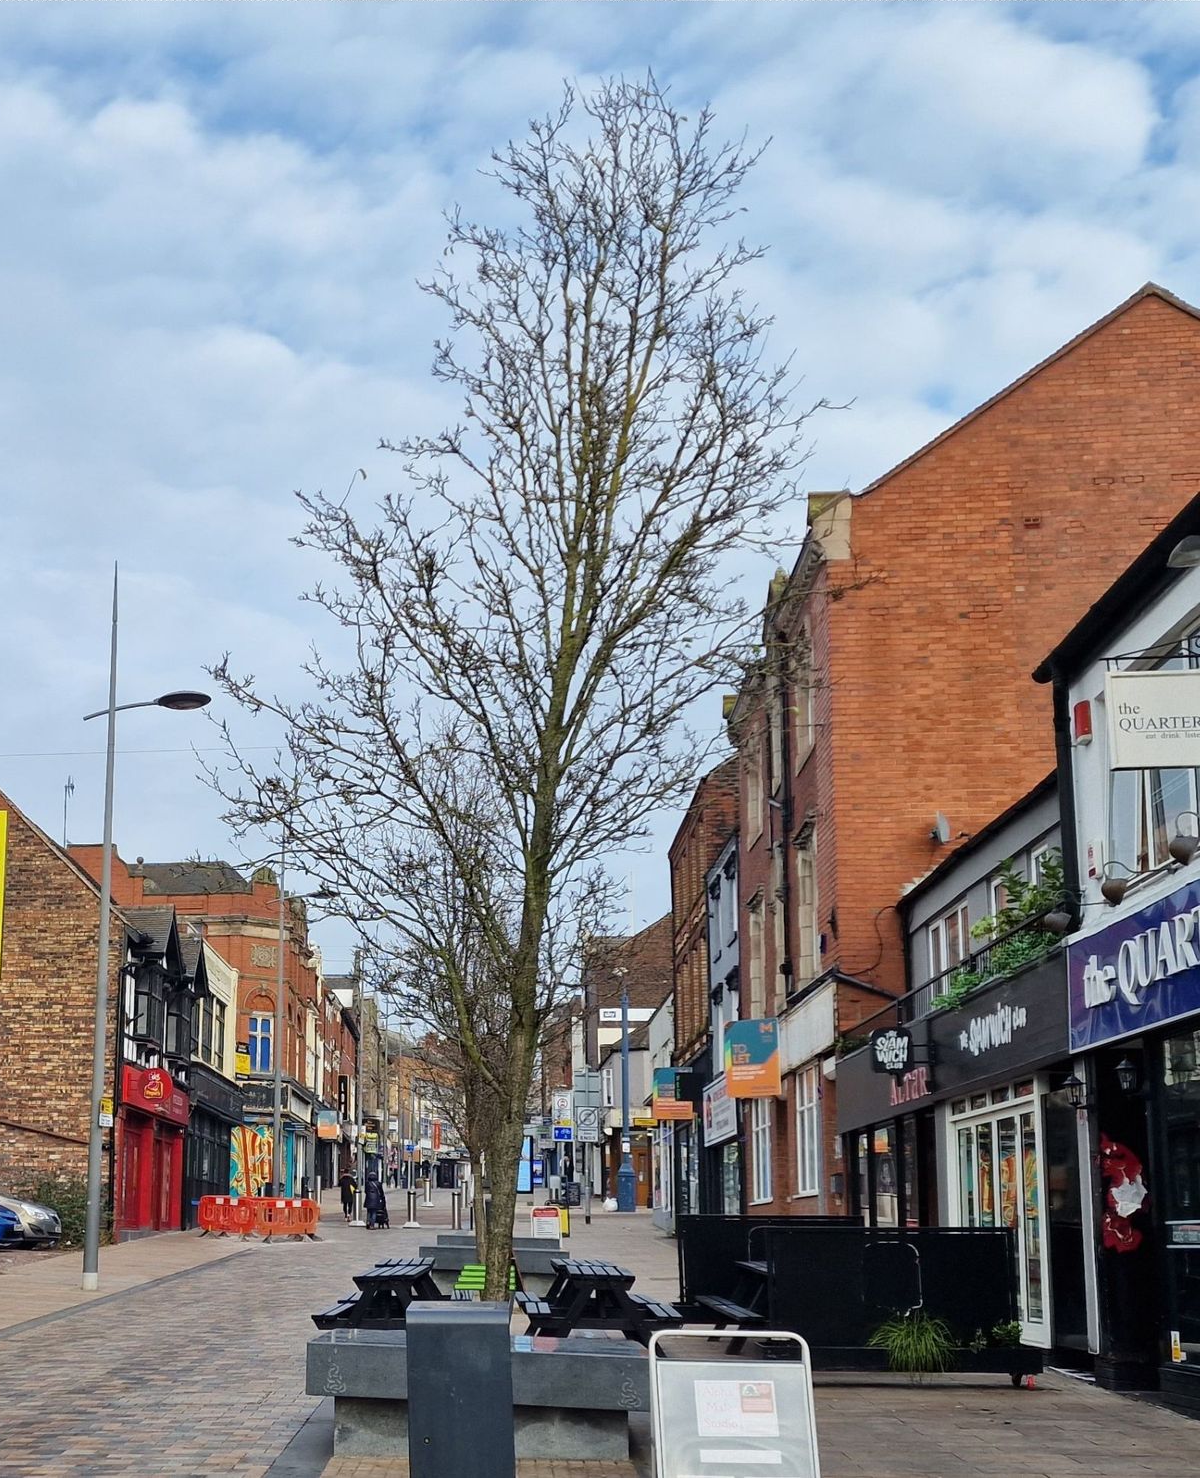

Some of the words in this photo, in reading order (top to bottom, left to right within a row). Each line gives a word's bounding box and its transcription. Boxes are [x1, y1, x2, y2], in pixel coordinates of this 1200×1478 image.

[1119, 702, 1140, 715] the
[1119, 715, 1200, 734] QUARTER
[1083, 954, 1117, 1009] the
[875, 1036, 909, 1052] SLAM
[876, 1048, 909, 1064] WICH
[885, 1062, 904, 1070] CLUB
